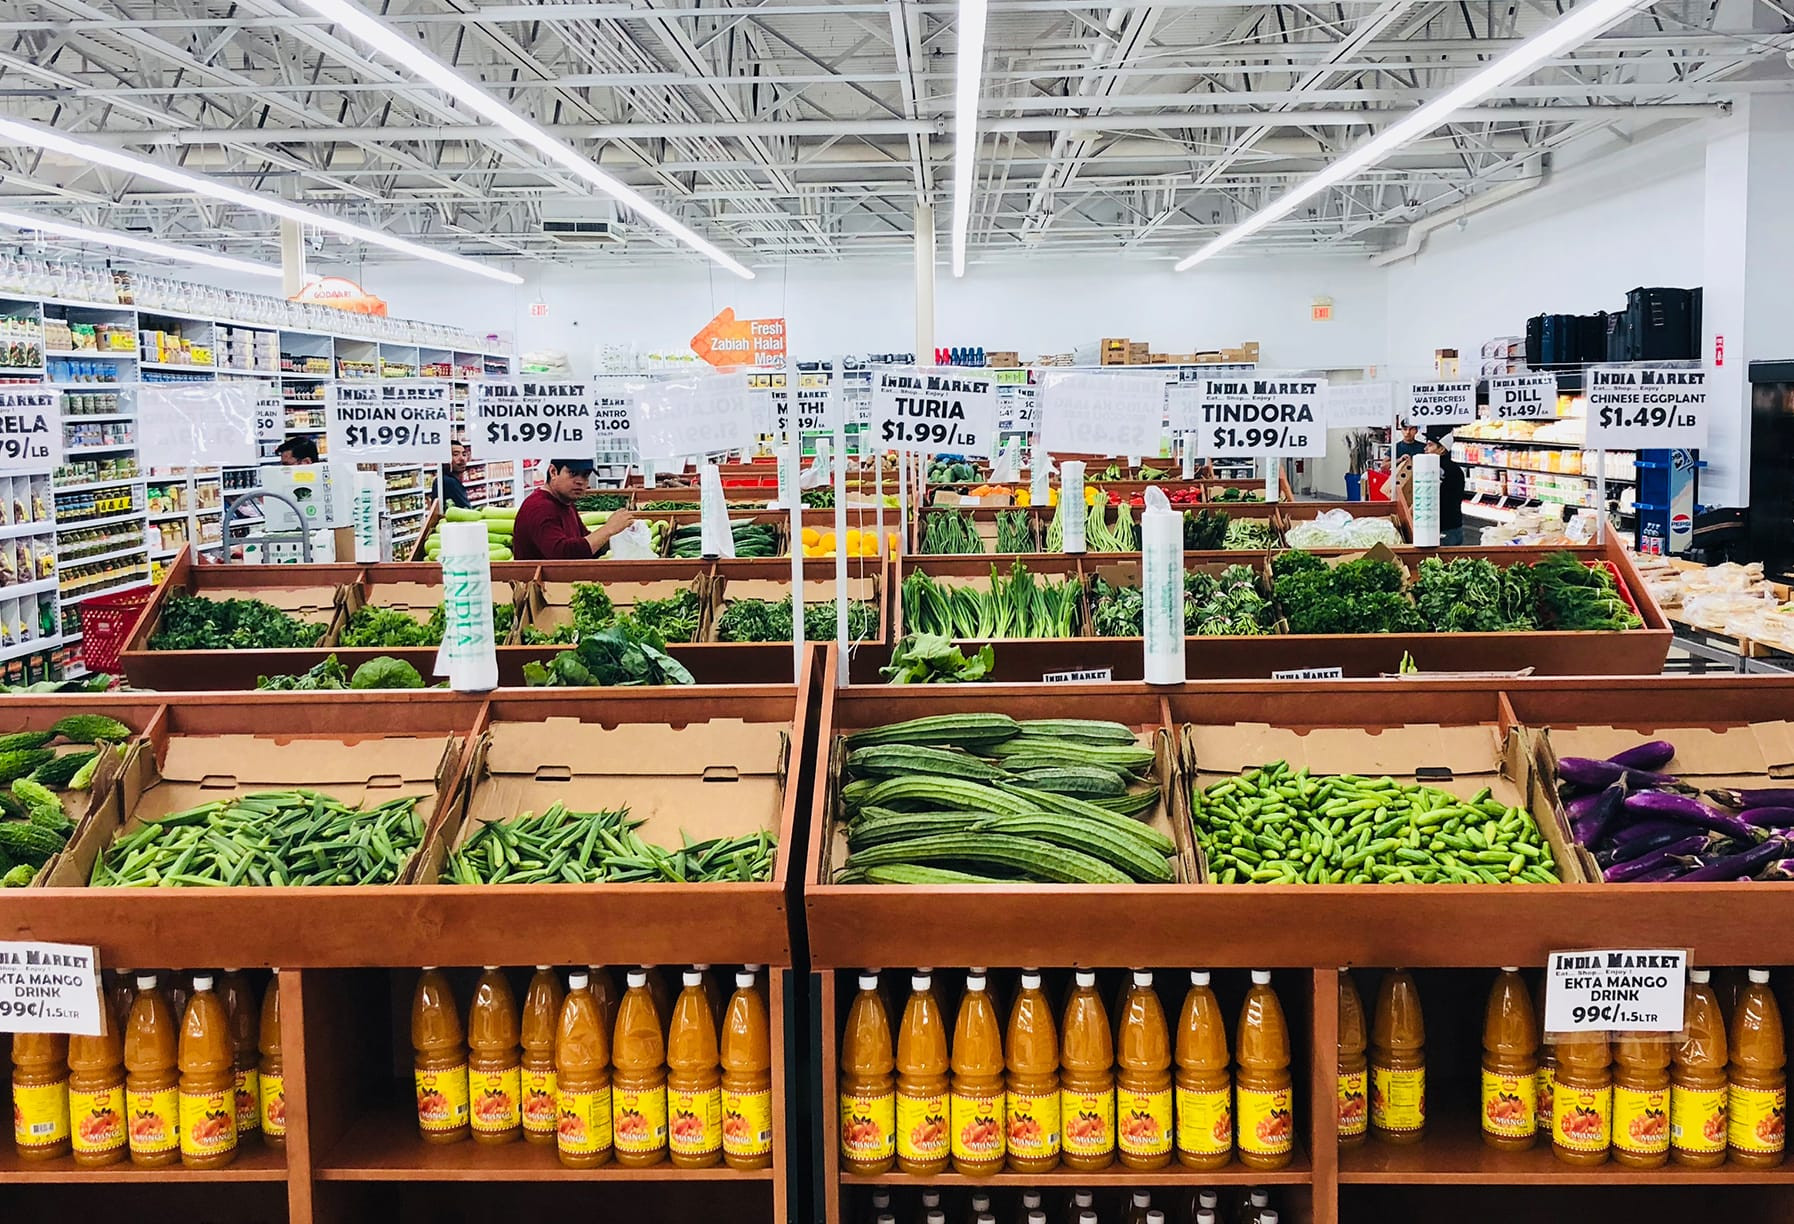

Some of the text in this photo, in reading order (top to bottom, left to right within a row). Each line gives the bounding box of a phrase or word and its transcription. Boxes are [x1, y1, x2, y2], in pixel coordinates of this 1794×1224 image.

[751, 321, 783, 335] Fresh
[711, 336, 783, 351] Zabiah Halal
[881, 374, 989, 393] INDIA MARKET
[1593, 371, 1705, 384] INDIA MARKET
[382, 386, 444, 400] MARKET
[478, 384, 585, 397] INDIA MARKET
[1206, 381, 1317, 395] INDIA MARKET
[1505, 389, 1541, 403] DILL
[1590, 394, 1706, 403] CHINESE EGGPLANT
[337, 407, 447, 421] INDIAN OKRA
[478, 404, 589, 417] INDIAN OKRA
[777, 402, 824, 414] MTHI
[895, 397, 965, 420] TURIA
[1201, 404, 1314, 423] TINDORA
[1412, 403, 1469, 417] $0.99/EA
[1600, 405, 1696, 429] $1.49/LB
[346, 424, 441, 447] $1.99/LB
[487, 420, 583, 444] $1.99/LB
[882, 419, 975, 445] $1.99/LB
[1213, 426, 1308, 449] $1.99/LB
[26, 950, 88, 968] MARKET
[1556, 953, 1680, 970] INDIA MARKET
[29, 974, 83, 987] MANGO
[1565, 976, 1667, 989] EKTA MANGO
[15, 987, 61, 997] DRINK
[1591, 990, 1639, 1001] DRINK
